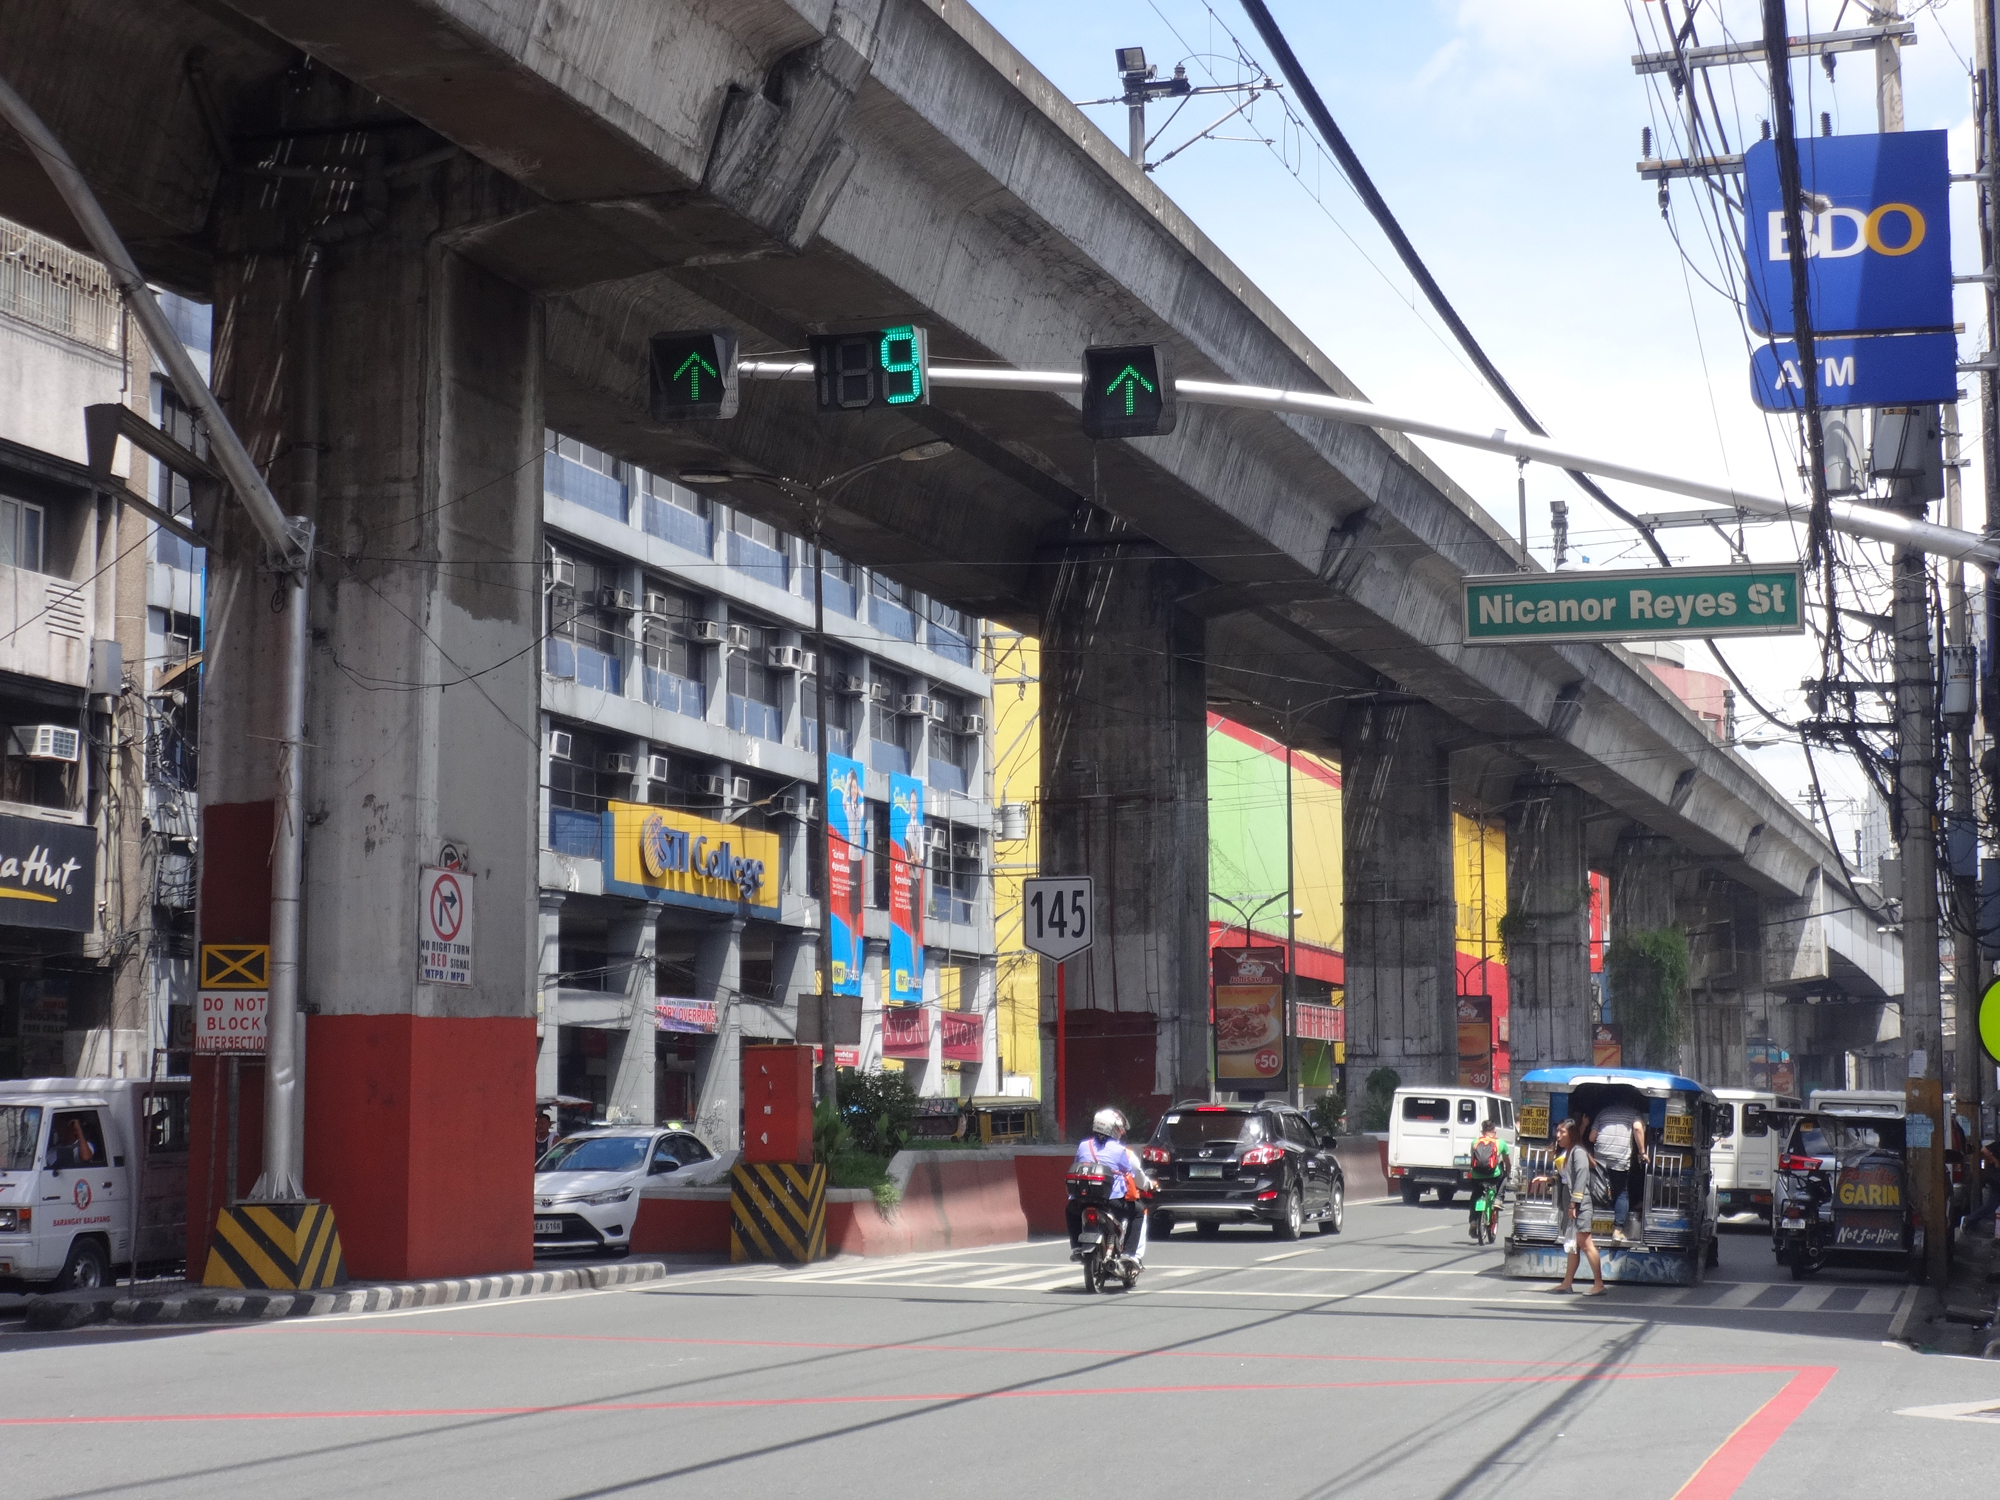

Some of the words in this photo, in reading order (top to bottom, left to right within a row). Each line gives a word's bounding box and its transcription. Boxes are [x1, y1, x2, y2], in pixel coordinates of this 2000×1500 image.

[1768, 203, 1926, 261] BDO
[881, 332, 921, 404] 9
[1774, 357, 1855, 390] AM
[1479, 594, 1616, 624] Nicanor
[1629, 589, 1737, 625] Reyes
[1748, 584, 1785, 614] St
[22, 845, 82, 890] Hut
[659, 826, 690, 873] STI
[693, 835, 765, 899] College
[1030, 890, 1086, 938] 145
[421, 940, 430, 951] NO
[431, 941, 451, 953] RIGHT
[453, 943, 470, 956] TURN
[431, 952, 447, 968] RED
[450, 958, 470, 970] SIGNAL
[425, 968, 444, 980] MTPB
[450, 971, 465, 983] MPD
[203, 997, 224, 1012] DO
[234, 997, 266, 1012] NOT
[678, 1008, 716, 1023] OVERRUNS
[207, 1016, 261, 1031] BLOCK
[884, 1018, 924, 1043] AVON
[943, 1022, 978, 1047] AVON
[1840, 1183, 1900, 1206] GARIN
[53, 1217, 82, 1227] BARANGAY
[1837, 1227, 1859, 1243] Not
[1858, 1229, 1876, 1243] for
[1876, 1227, 1899, 1244] Hire
